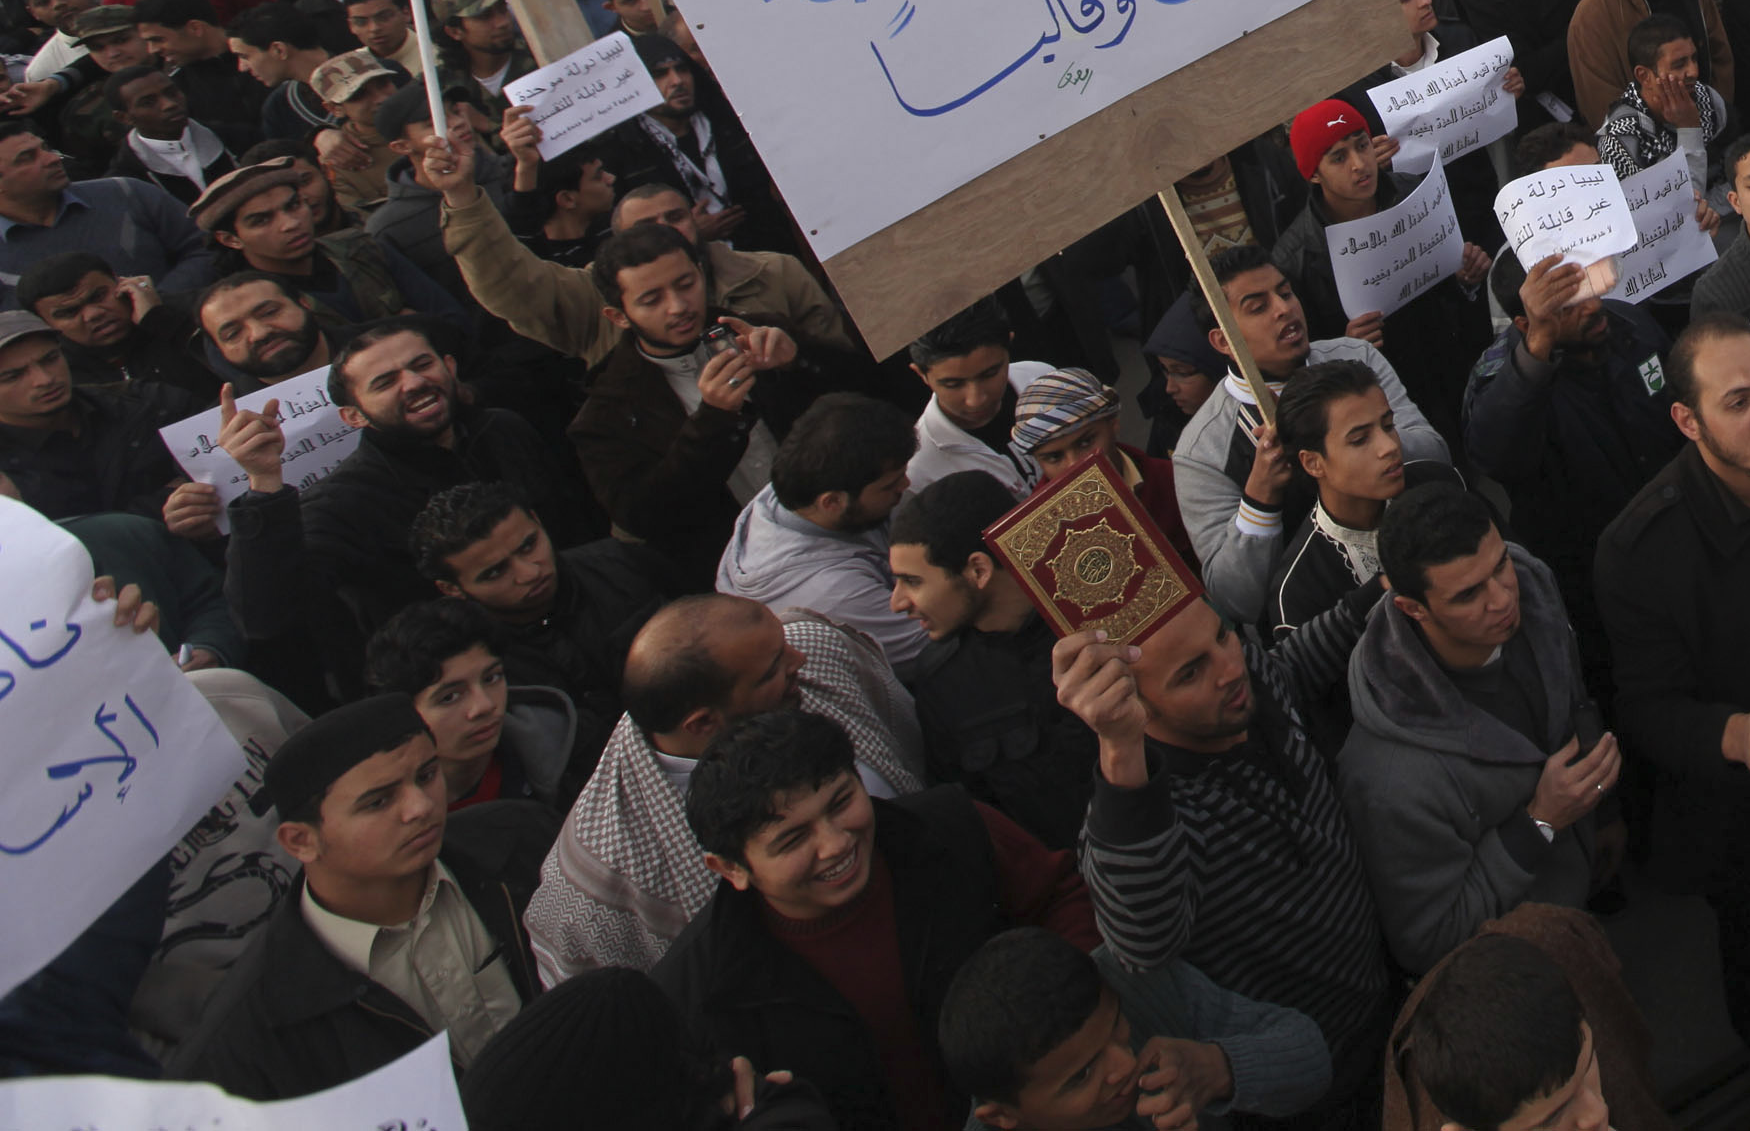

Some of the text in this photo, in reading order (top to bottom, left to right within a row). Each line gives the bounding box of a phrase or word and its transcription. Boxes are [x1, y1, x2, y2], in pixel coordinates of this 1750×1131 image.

[516, 40, 624, 102] ليبيا دولة موحدة
[1493, 54, 1508, 71] نحن
[577, 79, 607, 100] قابلة
[614, 69, 634, 88] غير
[1529, 170, 1604, 199] ليبيا دولة
[1537, 197, 1611, 232] غير قابلة
